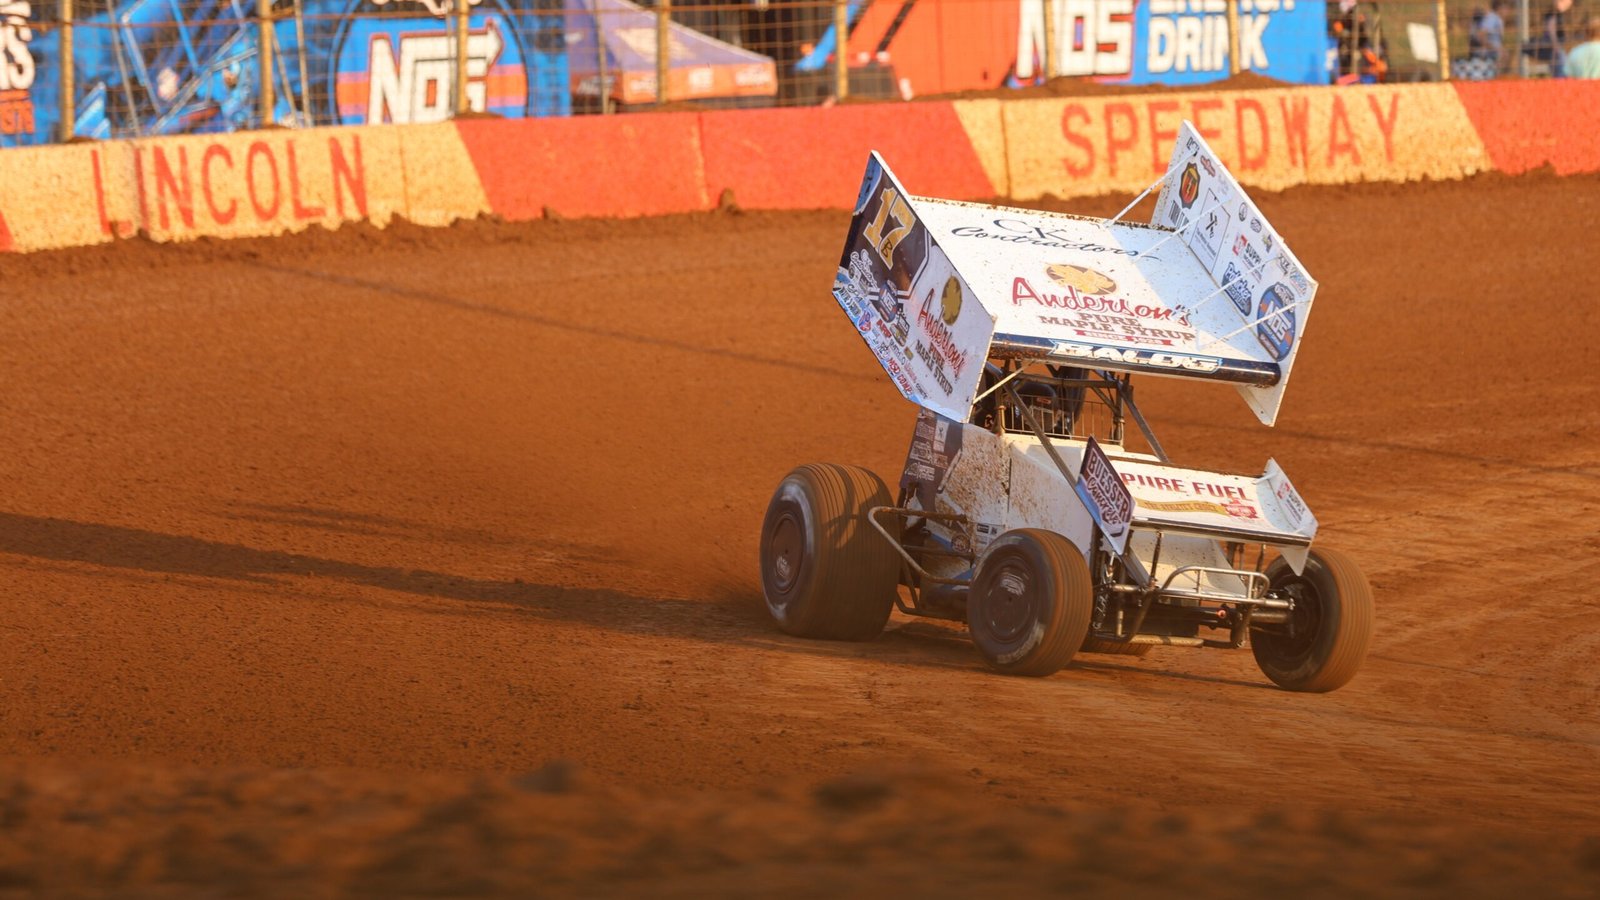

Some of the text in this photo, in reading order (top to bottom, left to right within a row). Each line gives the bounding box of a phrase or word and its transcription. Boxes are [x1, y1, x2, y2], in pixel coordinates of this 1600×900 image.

[1015, 0, 1132, 79] NOS
[1147, 15, 1270, 73] DRINK
[91, 134, 368, 238] LINCOLN
[862, 186, 917, 270] 17
[951, 226, 1161, 260] Contractors
[1012, 276, 1193, 328] Anderson's
[1038, 315, 1197, 342] MAPLE SYRUP
[1077, 312, 1142, 328] PURE
[915, 339, 933, 372] MAPLE
[933, 366, 953, 397] SYRUP
[928, 341, 946, 371] PURE
[1087, 451, 1130, 523] BUESSER
[1119, 472, 1254, 502] PURE FUEL
